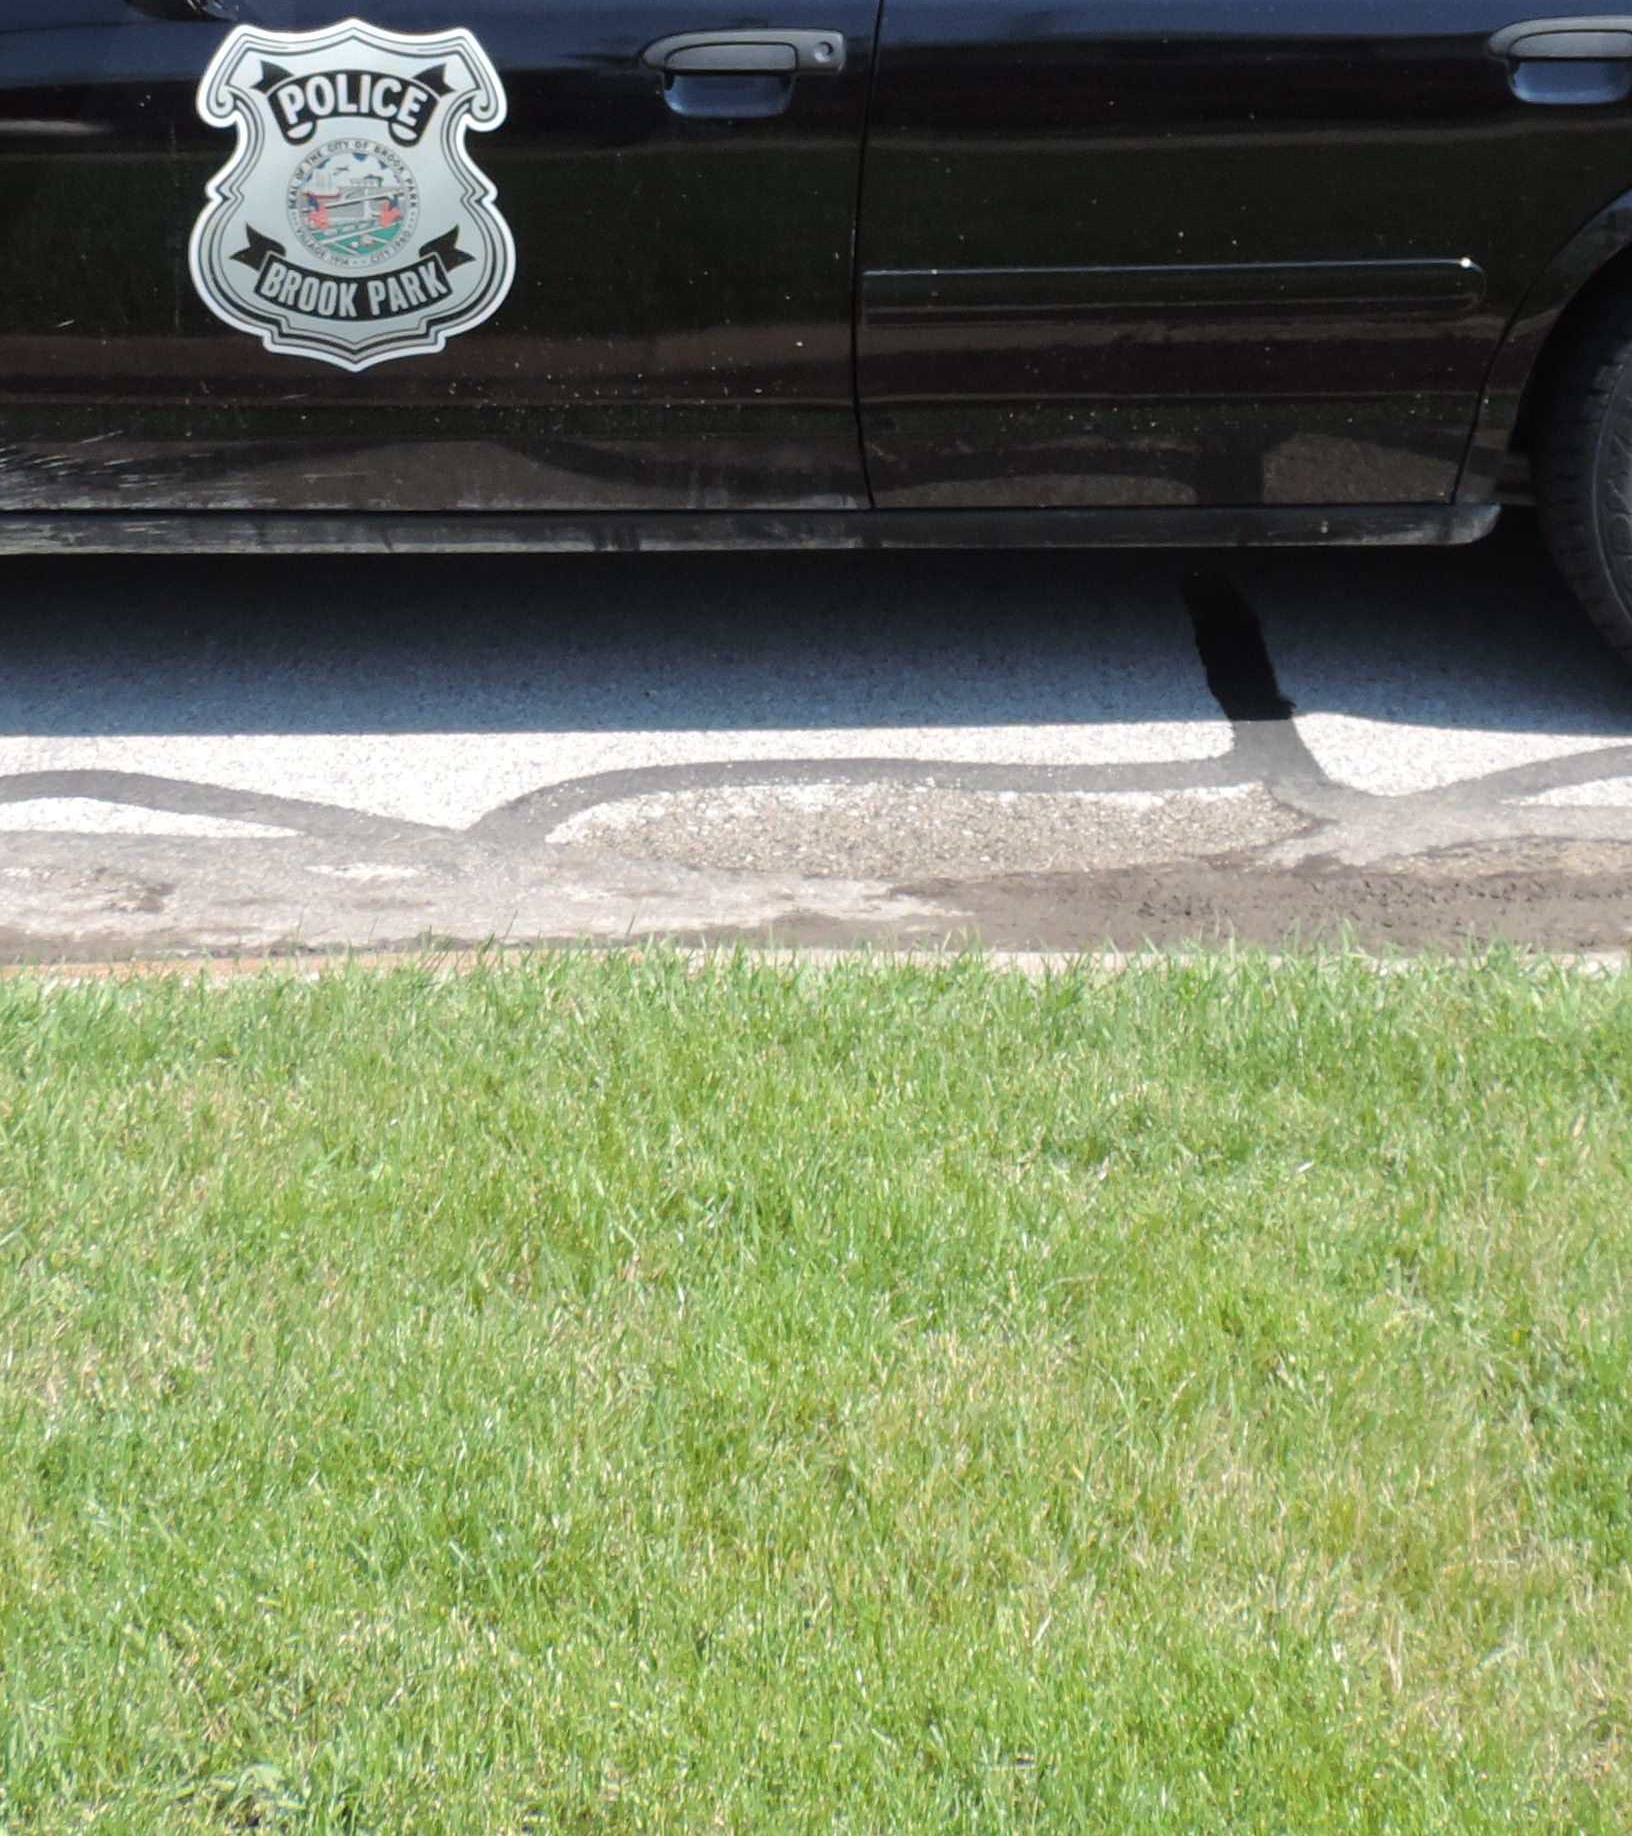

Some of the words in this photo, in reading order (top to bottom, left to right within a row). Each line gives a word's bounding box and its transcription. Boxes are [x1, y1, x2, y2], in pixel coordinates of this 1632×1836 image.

[277, 73, 430, 127] POLICE
[326, 141, 350, 153] CITY
[354, 140, 370, 149] OF
[373, 145, 406, 173] BROOK
[404, 177, 418, 208] PARK
[261, 261, 358, 318] BROOK
[368, 267, 449, 317] PARK
